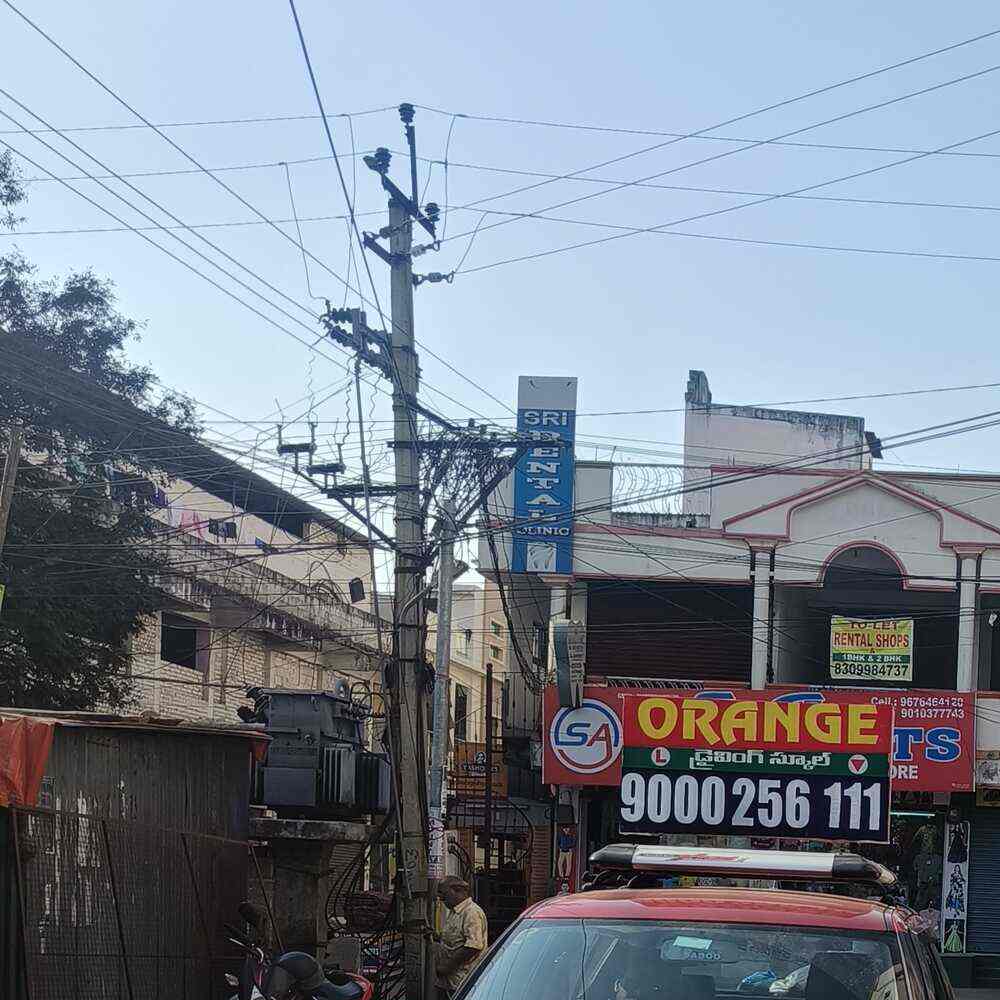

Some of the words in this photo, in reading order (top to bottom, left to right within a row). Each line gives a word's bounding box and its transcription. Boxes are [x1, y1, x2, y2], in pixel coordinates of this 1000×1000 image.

[524, 411, 568, 426] SRI
[834, 632, 873, 646] RENTAL
[875, 633, 910, 648] SHOPS
[842, 653, 866, 661] 1BHK
[834, 662, 909, 677] 8309984737
[901, 708, 965, 719] 9010377743
[637, 697, 880, 746] ORANGE
[621, 772, 727, 827] 9000
[731, 779, 810, 829] 256
[823, 781, 881, 831] 111
